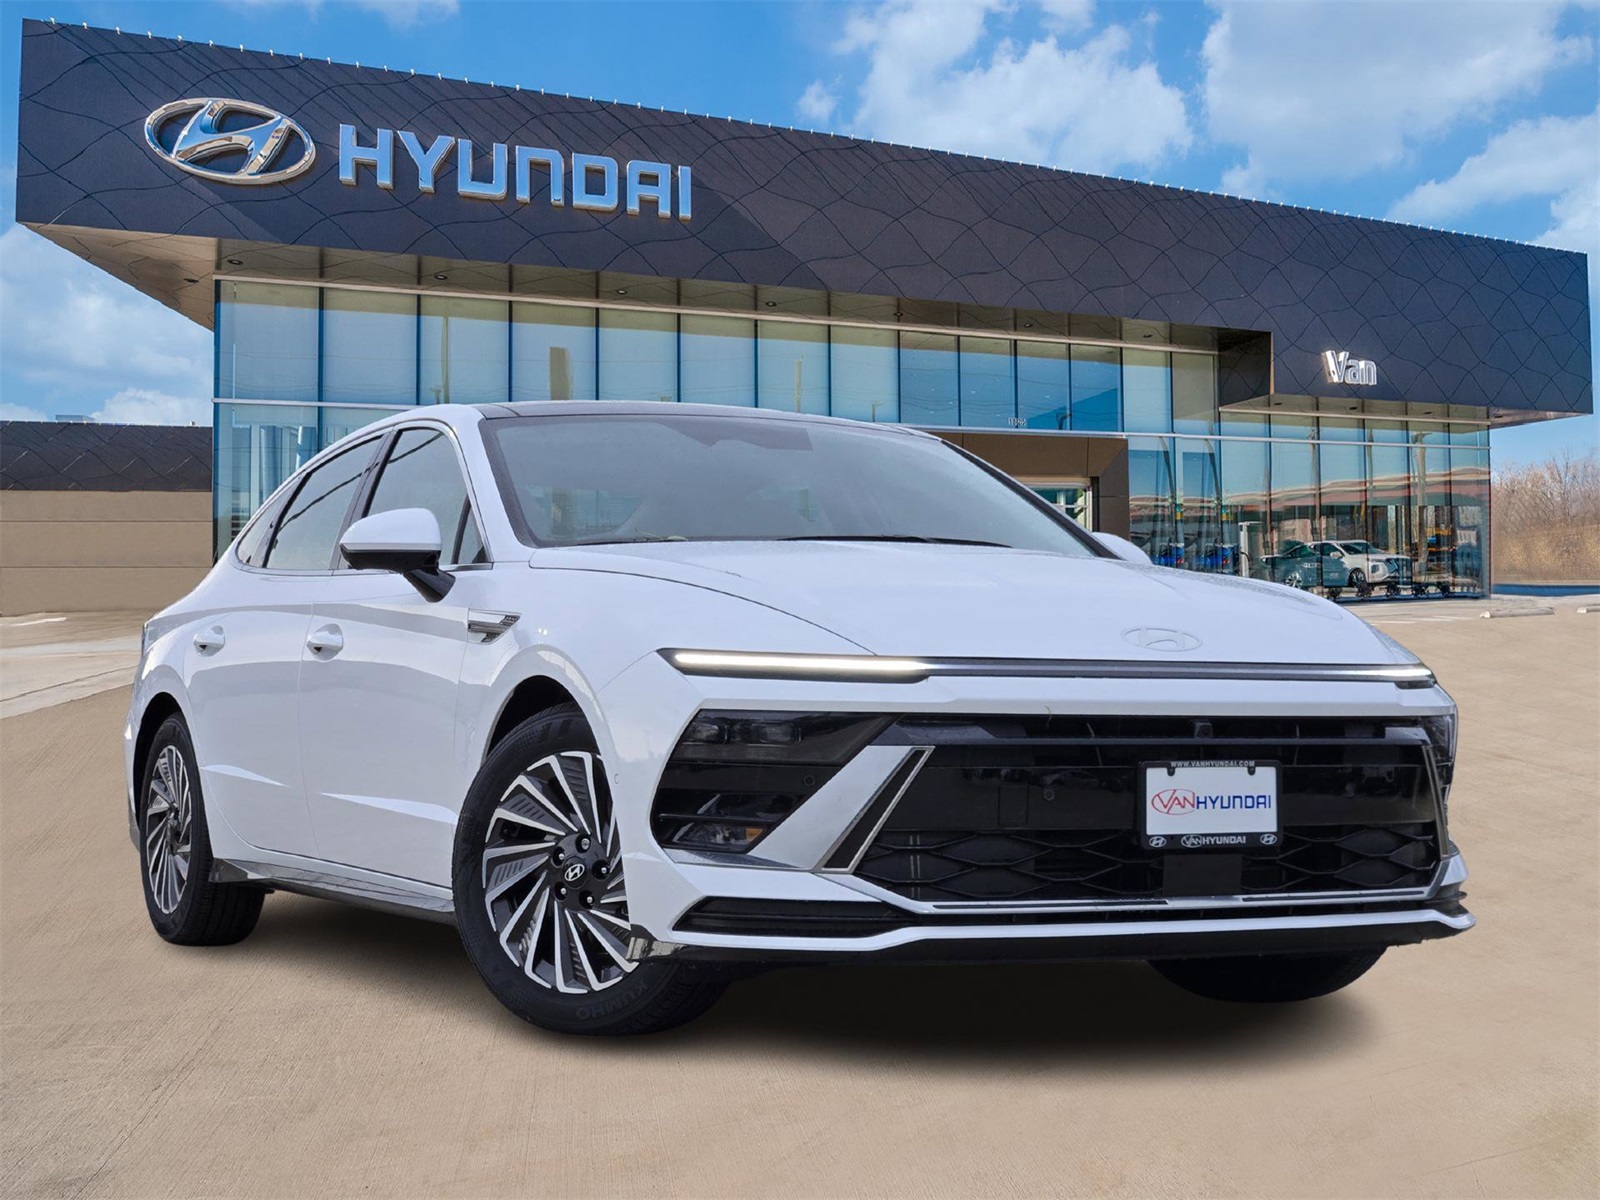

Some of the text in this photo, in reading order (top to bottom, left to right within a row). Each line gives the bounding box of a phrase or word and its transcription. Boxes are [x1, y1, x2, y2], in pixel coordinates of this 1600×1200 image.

[339, 123, 692, 220] HYUNDAI
[1321, 350, 1377, 386] Van
[576, 979, 649, 1020] KUMHO
